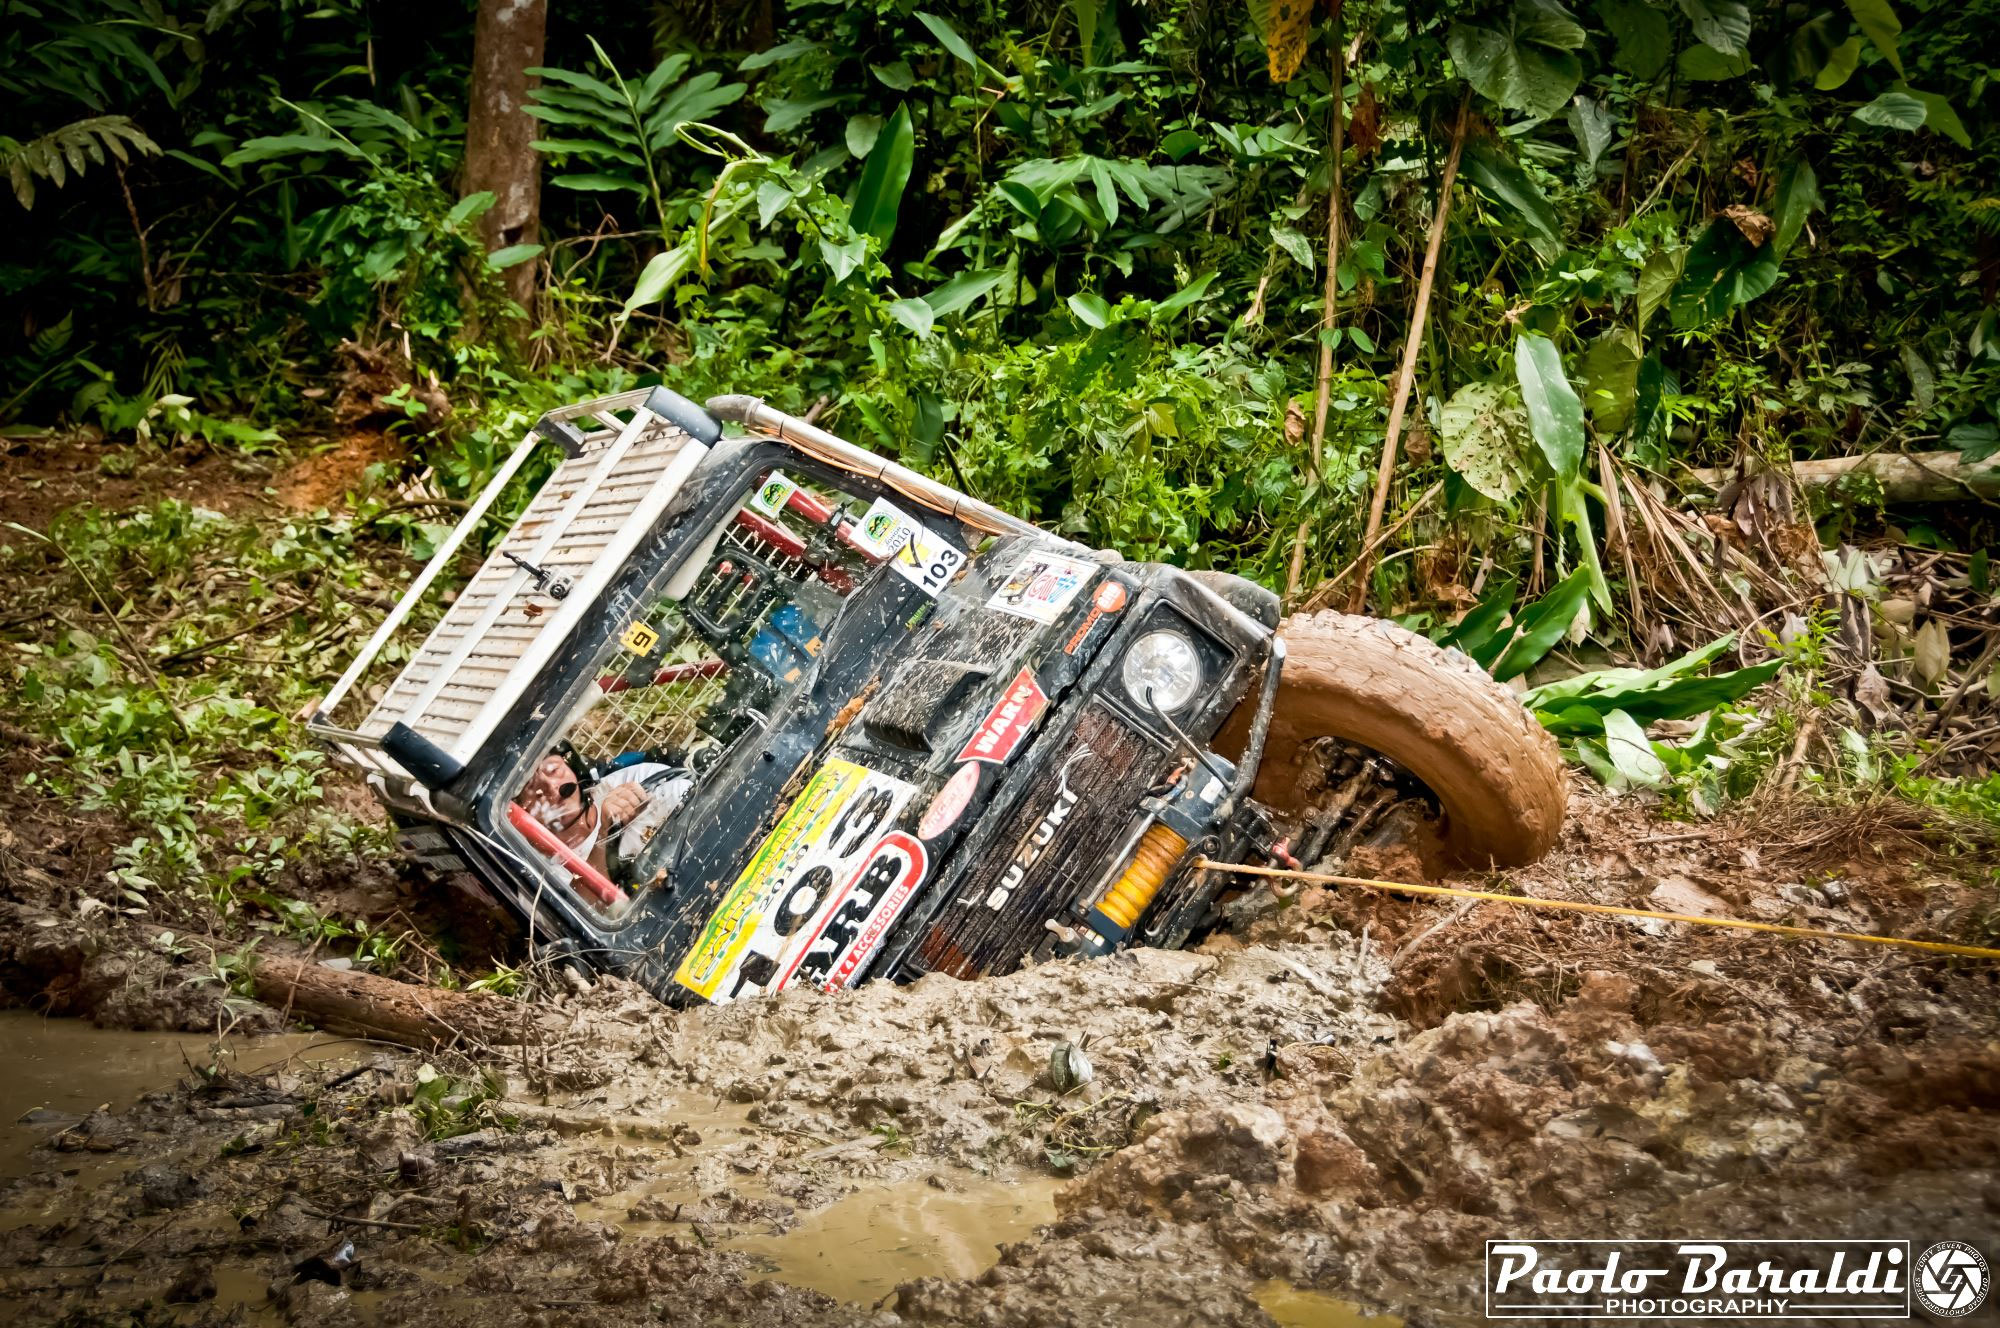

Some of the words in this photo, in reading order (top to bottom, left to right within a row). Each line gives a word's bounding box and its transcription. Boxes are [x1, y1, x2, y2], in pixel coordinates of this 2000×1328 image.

[888, 527, 911, 554] 2010
[922, 549, 959, 588] 103
[1063, 607, 1103, 655] PROMO
[975, 685, 1034, 754] WARN
[758, 844, 809, 913] 2010
[985, 792, 1079, 911] SUZUKI
[729, 786, 893, 998] 103
[792, 854, 902, 986] ARB
[844, 960, 855, 970] 4
[853, 884, 909, 960] ACCESSORIES
